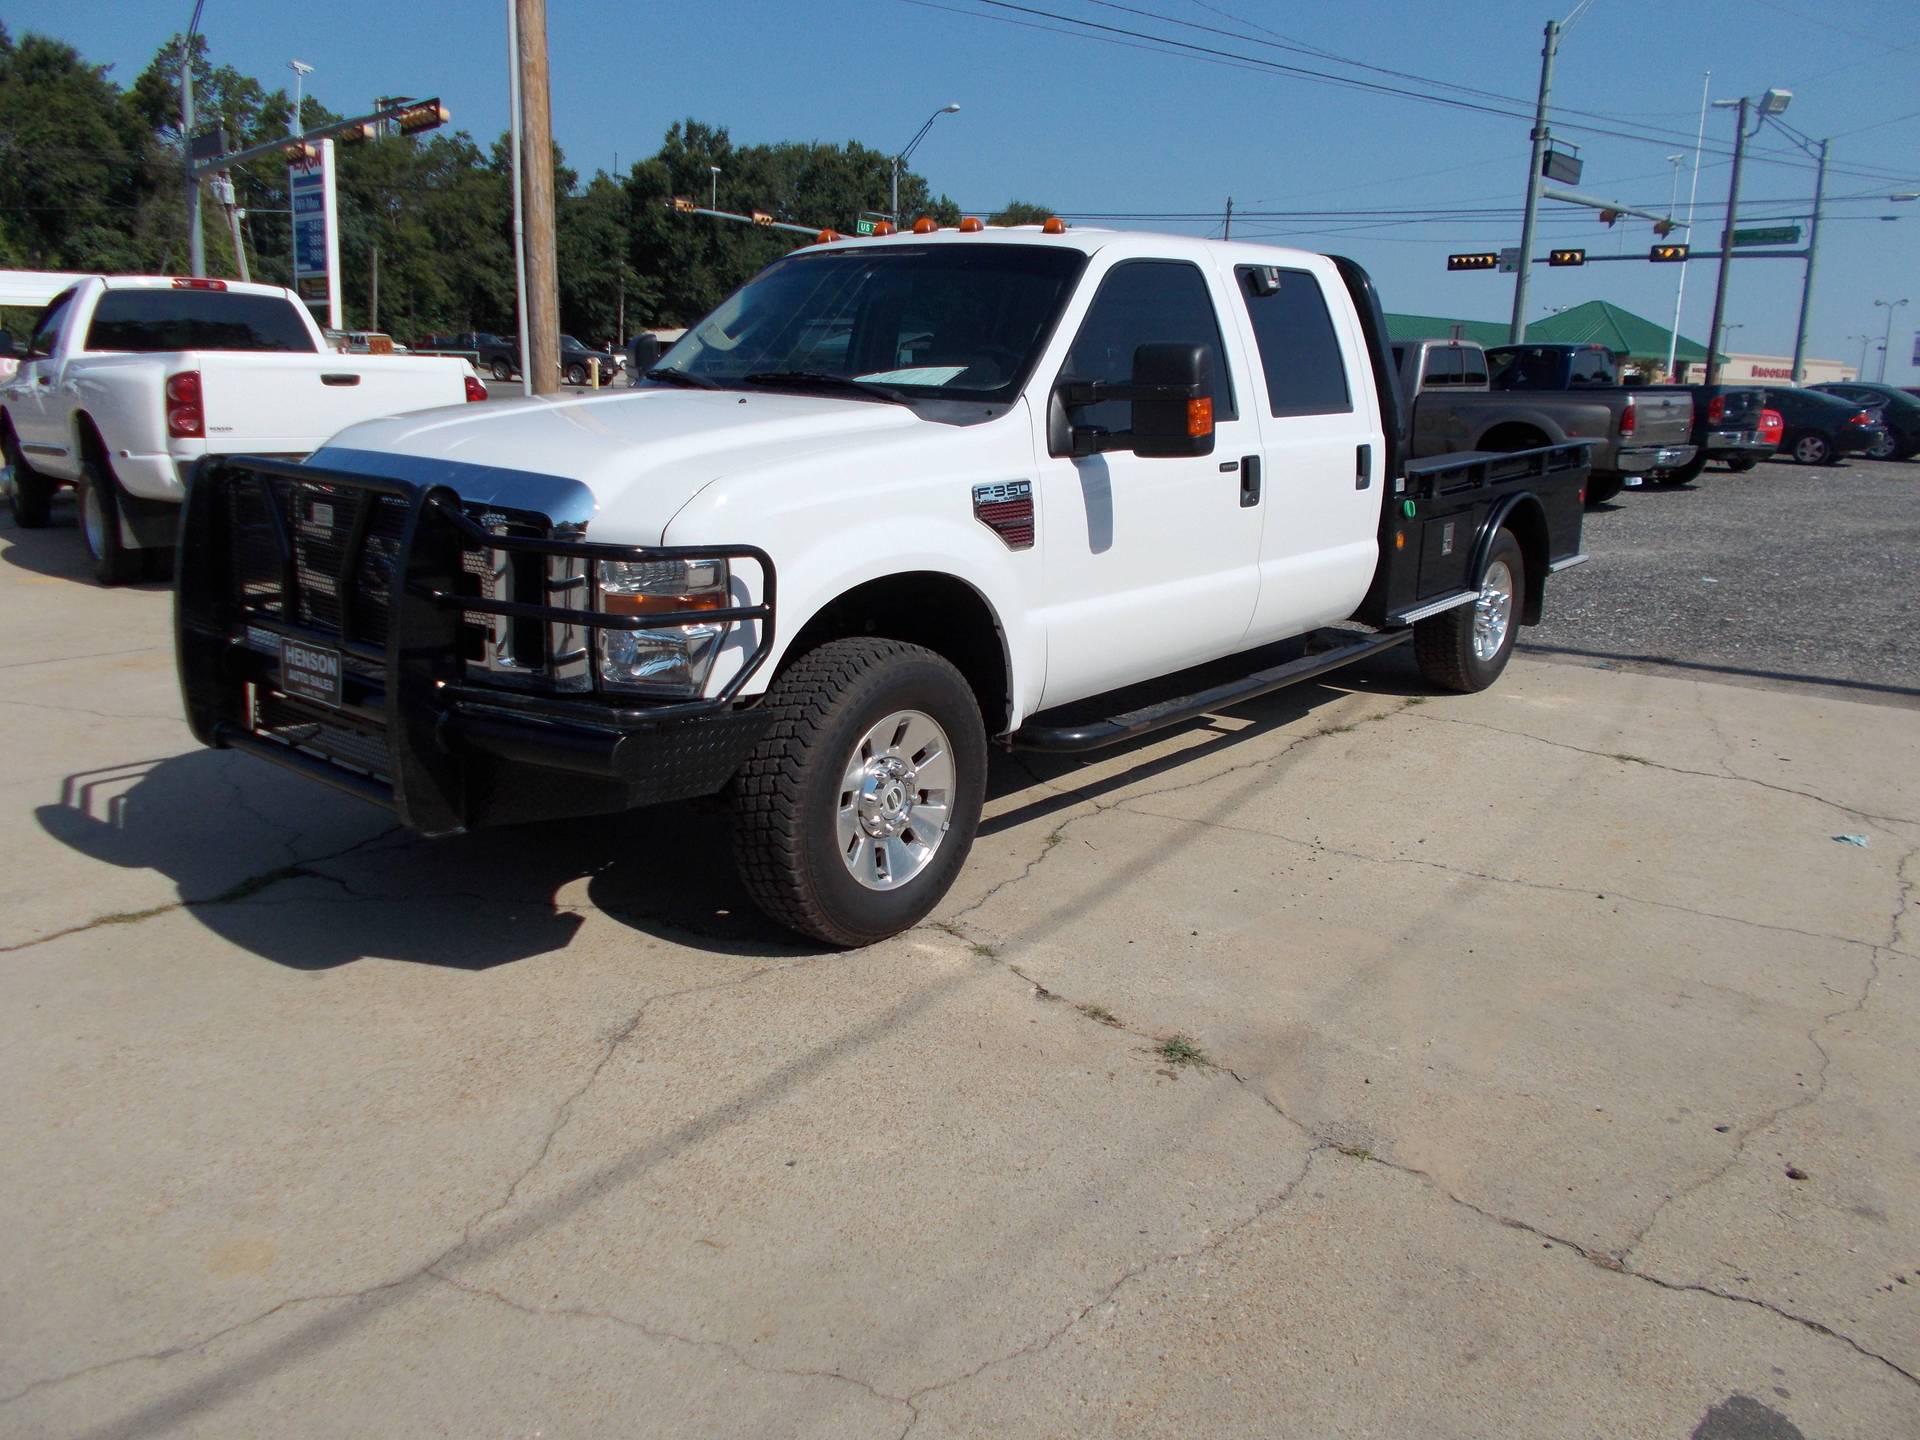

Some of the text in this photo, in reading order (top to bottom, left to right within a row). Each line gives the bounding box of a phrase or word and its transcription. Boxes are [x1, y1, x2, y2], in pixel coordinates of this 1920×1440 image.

[860, 222, 870, 232] US
[285, 645, 337, 676] HENSON
[288, 669, 334, 691] AUTO SALES
